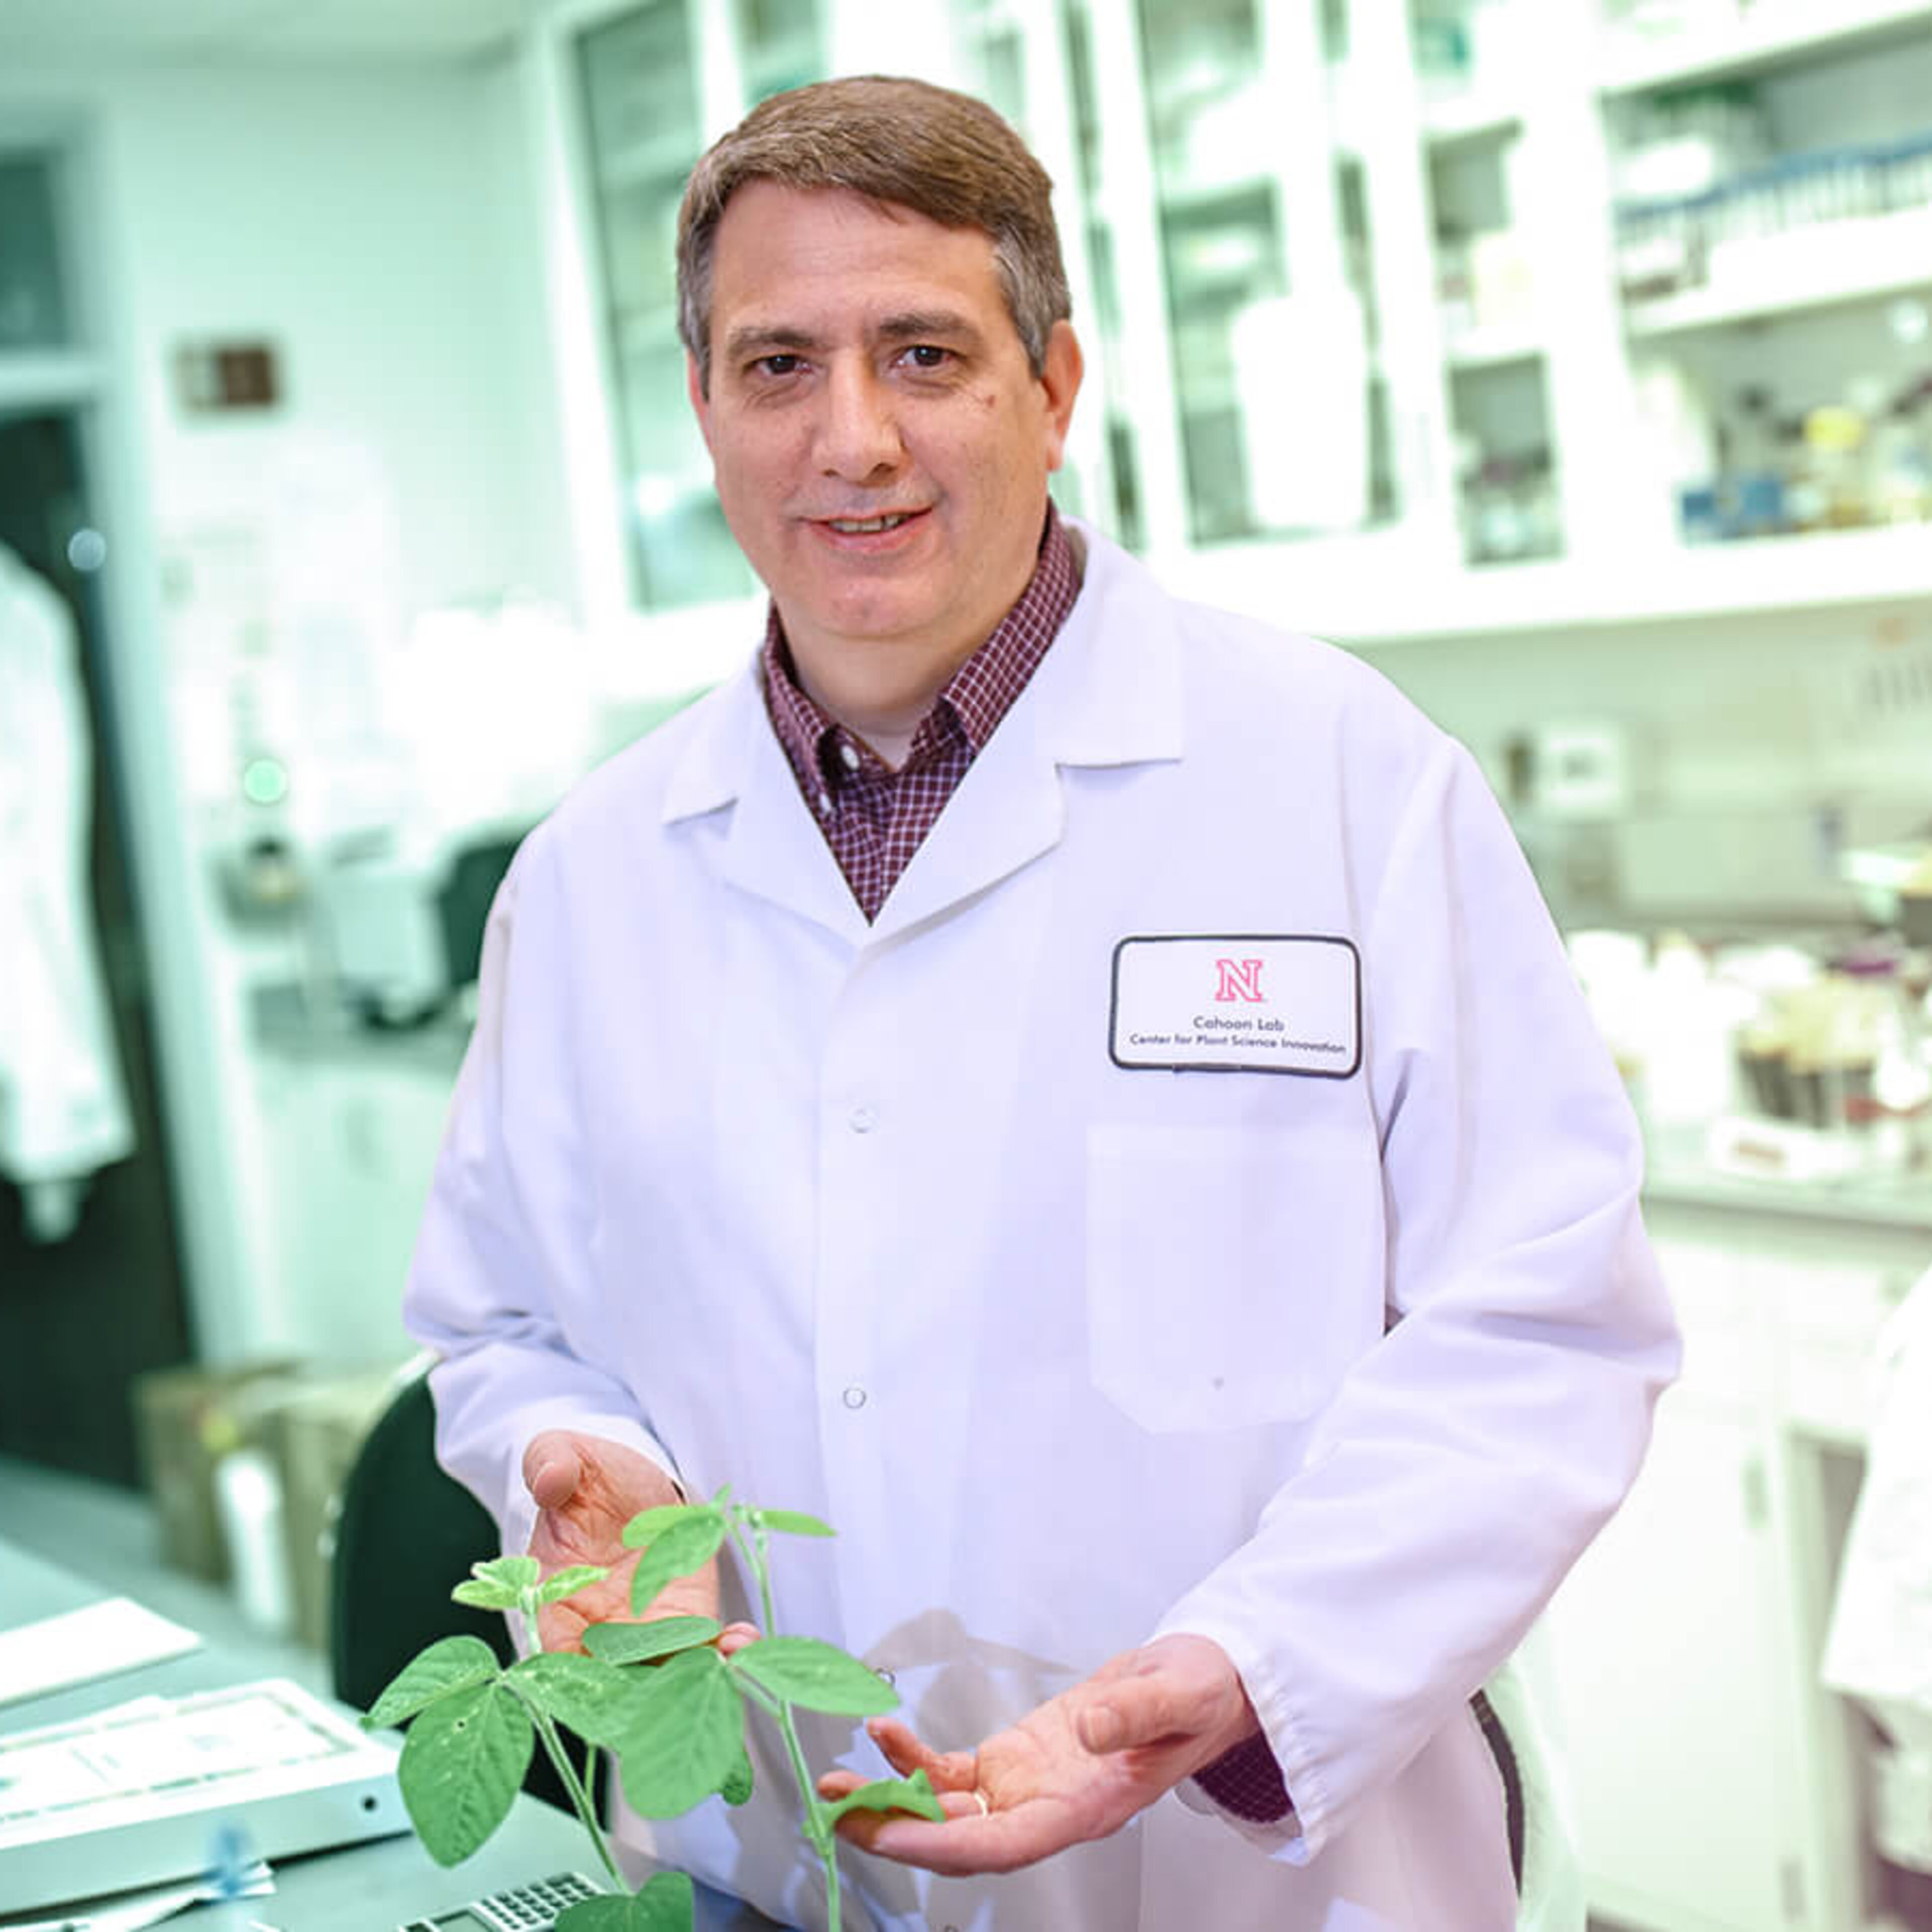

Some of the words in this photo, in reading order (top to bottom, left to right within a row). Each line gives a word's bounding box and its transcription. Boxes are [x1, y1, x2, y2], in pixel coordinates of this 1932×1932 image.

[1215, 958, 1263, 1003] N
[1193, 1015, 1252, 1031] Cahoon
[1258, 1018, 1284, 1032] Lab
[1130, 1034, 1170, 1046] Center
[1174, 1034, 1192, 1045] for
[1196, 1035, 1228, 1045] Plant
[1231, 1035, 1277, 1049] Science
[1281, 1038, 1346, 1054] Innovation
